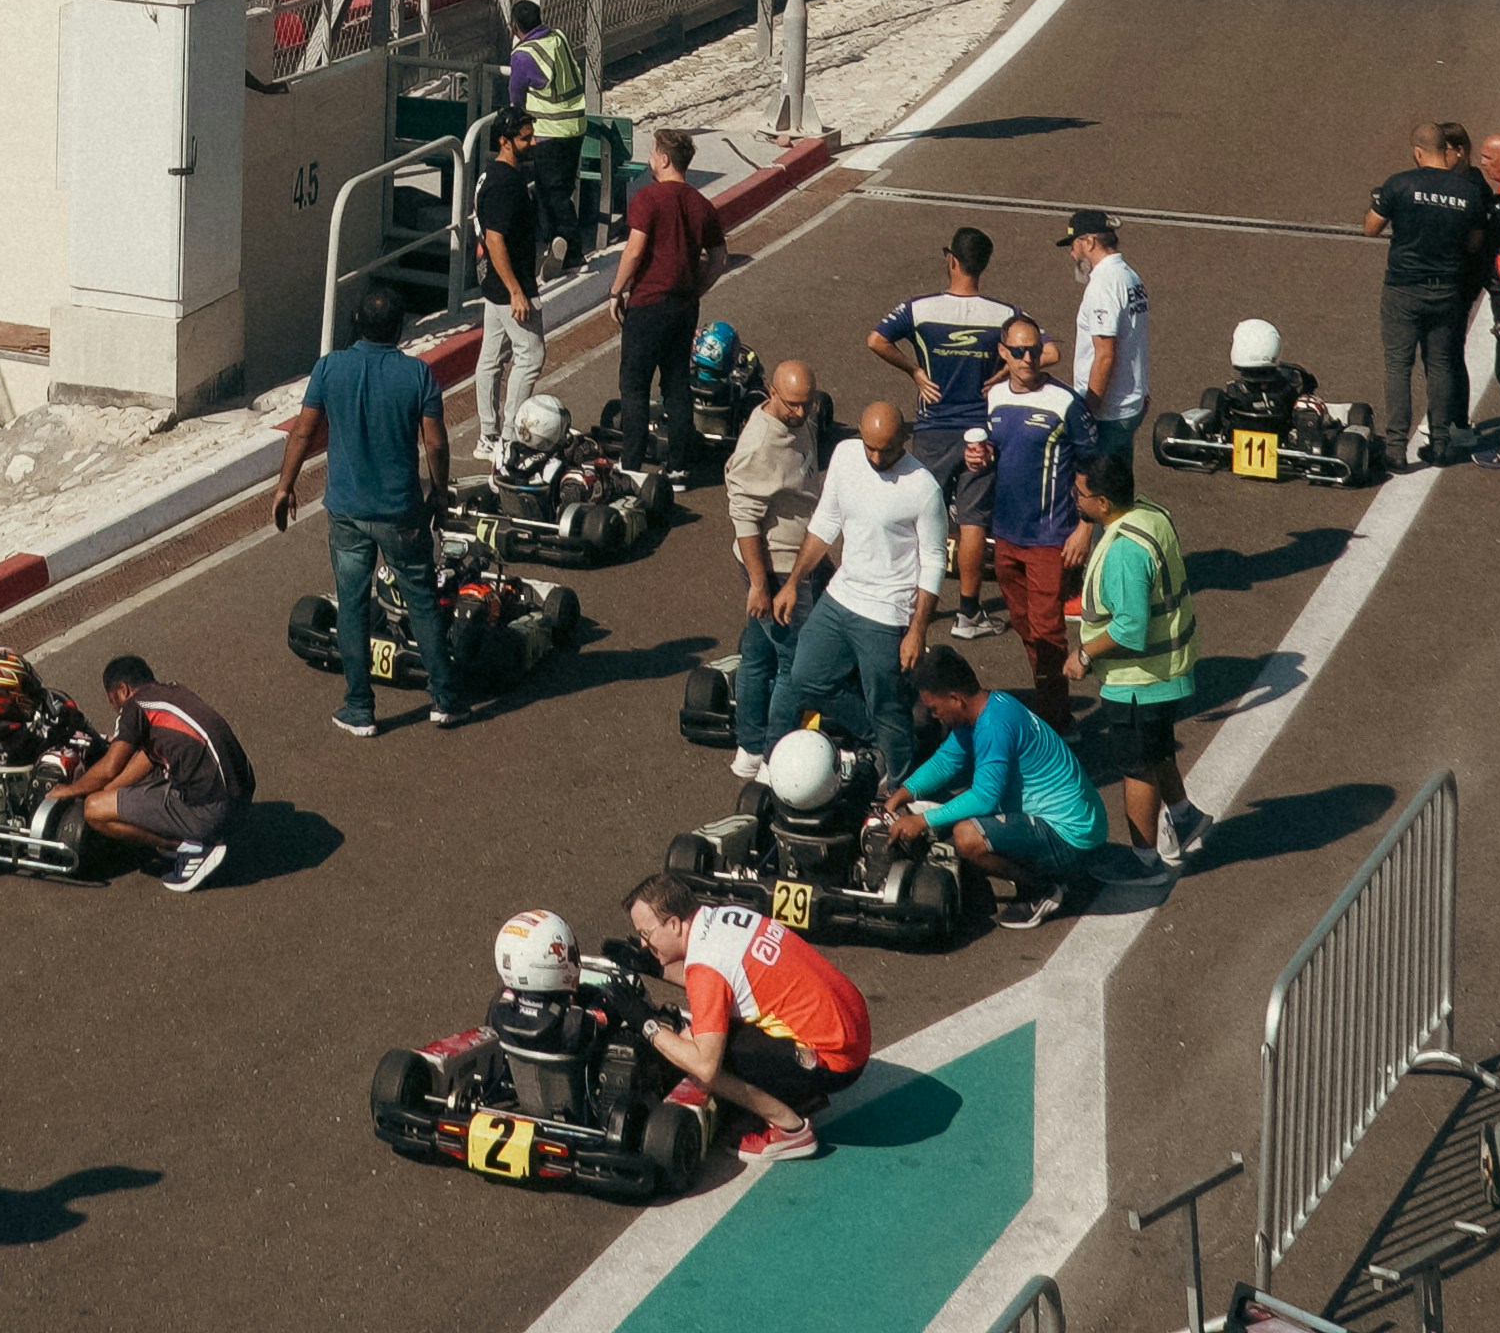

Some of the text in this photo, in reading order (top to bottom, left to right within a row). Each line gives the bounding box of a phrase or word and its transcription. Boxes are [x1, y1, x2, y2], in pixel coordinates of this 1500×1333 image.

[293, 162, 319, 209] 4.5
[1414, 191, 1467, 208] ELEVEN
[1244, 437, 1266, 468] 11
[722, 910, 753, 929] 2
[775, 884, 808, 925] 29
[485, 1117, 516, 1173] 2
